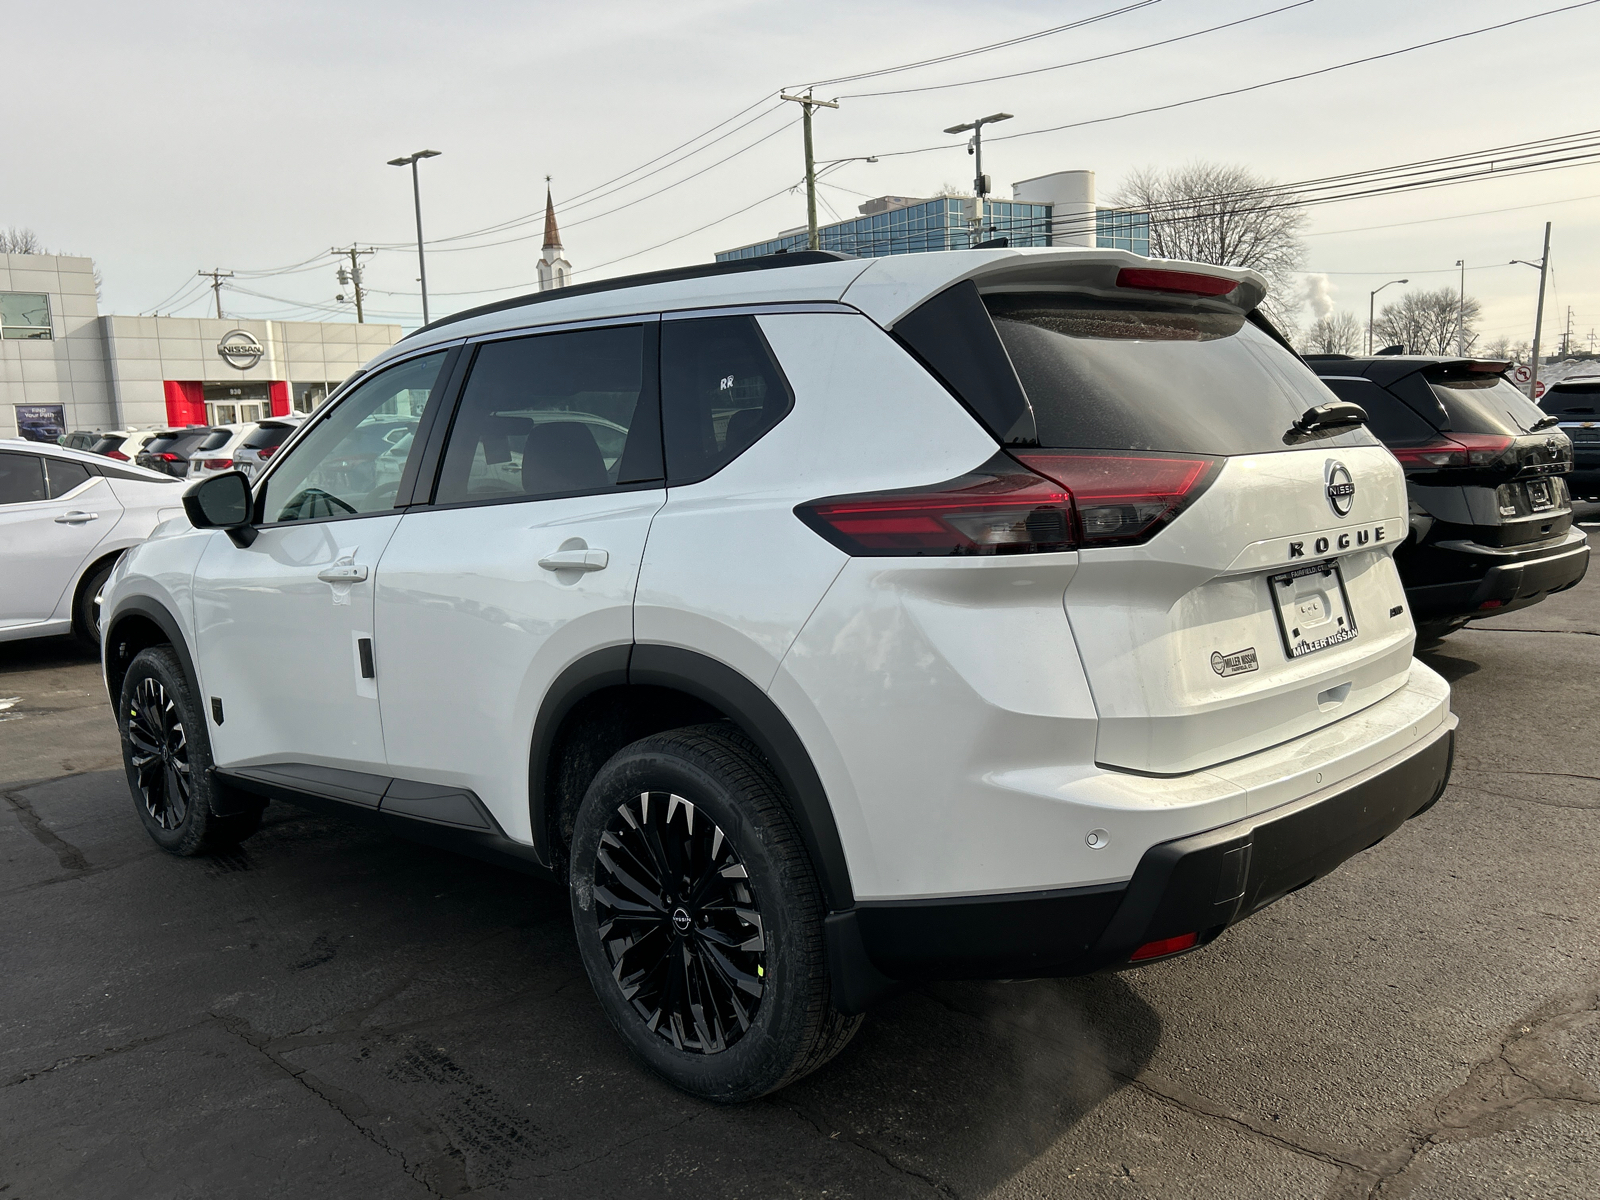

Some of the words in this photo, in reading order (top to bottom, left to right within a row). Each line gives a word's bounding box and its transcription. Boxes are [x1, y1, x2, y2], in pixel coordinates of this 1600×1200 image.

[223, 345, 261, 353] NISSAN
[720, 375, 734, 390] RR
[1289, 526, 1385, 558] ROGUE
[1292, 639, 1327, 657] MILLER
[1328, 629, 1358, 645] NISSAN
